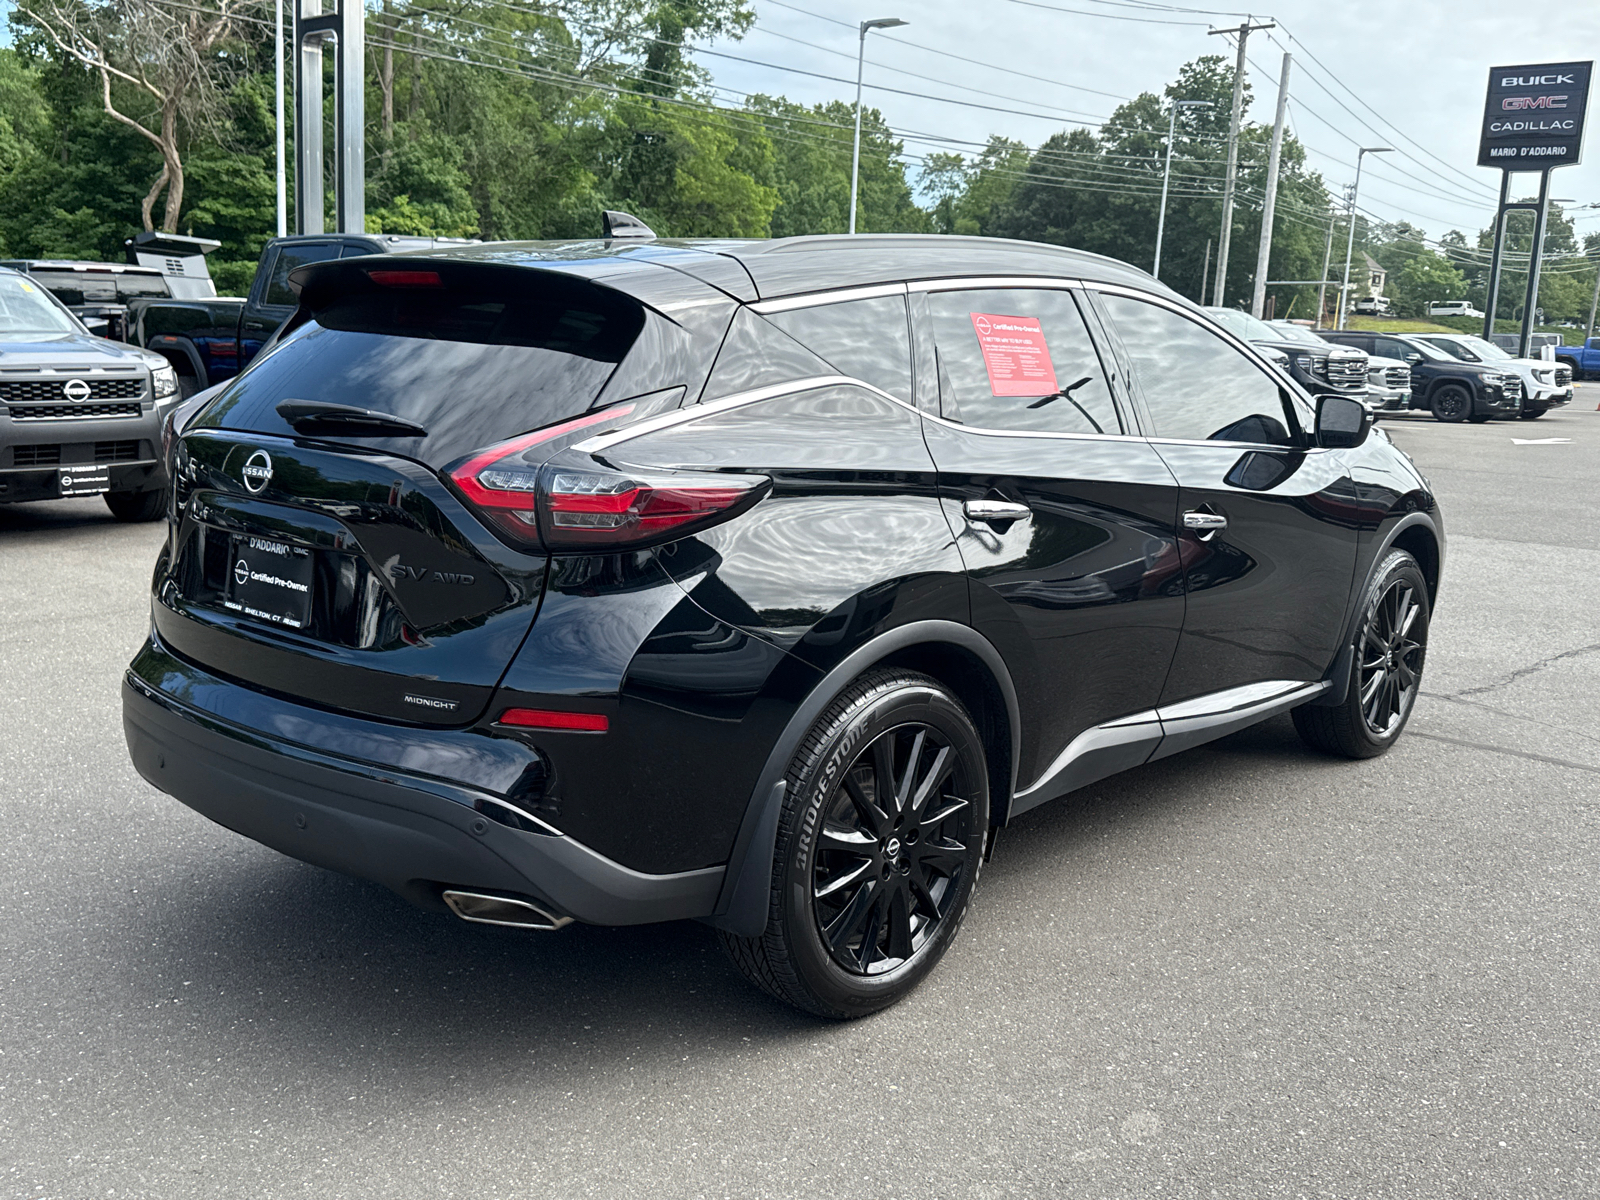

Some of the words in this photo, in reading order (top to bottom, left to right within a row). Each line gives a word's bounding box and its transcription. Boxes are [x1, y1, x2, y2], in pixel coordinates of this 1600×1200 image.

[1501, 74, 1575, 87] BUICK
[1502, 95, 1568, 110] GMC
[1490, 120, 1574, 132] CADILLAC
[1490, 147, 1517, 157] MARIO
[1520, 146, 1567, 156] D'ADDARIO
[250, 571, 274, 584] Certified
[390, 564, 428, 582] SV
[432, 571, 476, 586] AWD
[272, 614, 281, 622] CT
[404, 695, 457, 710] MIDNIGHT
[796, 713, 871, 871] BRIDGESTONE
